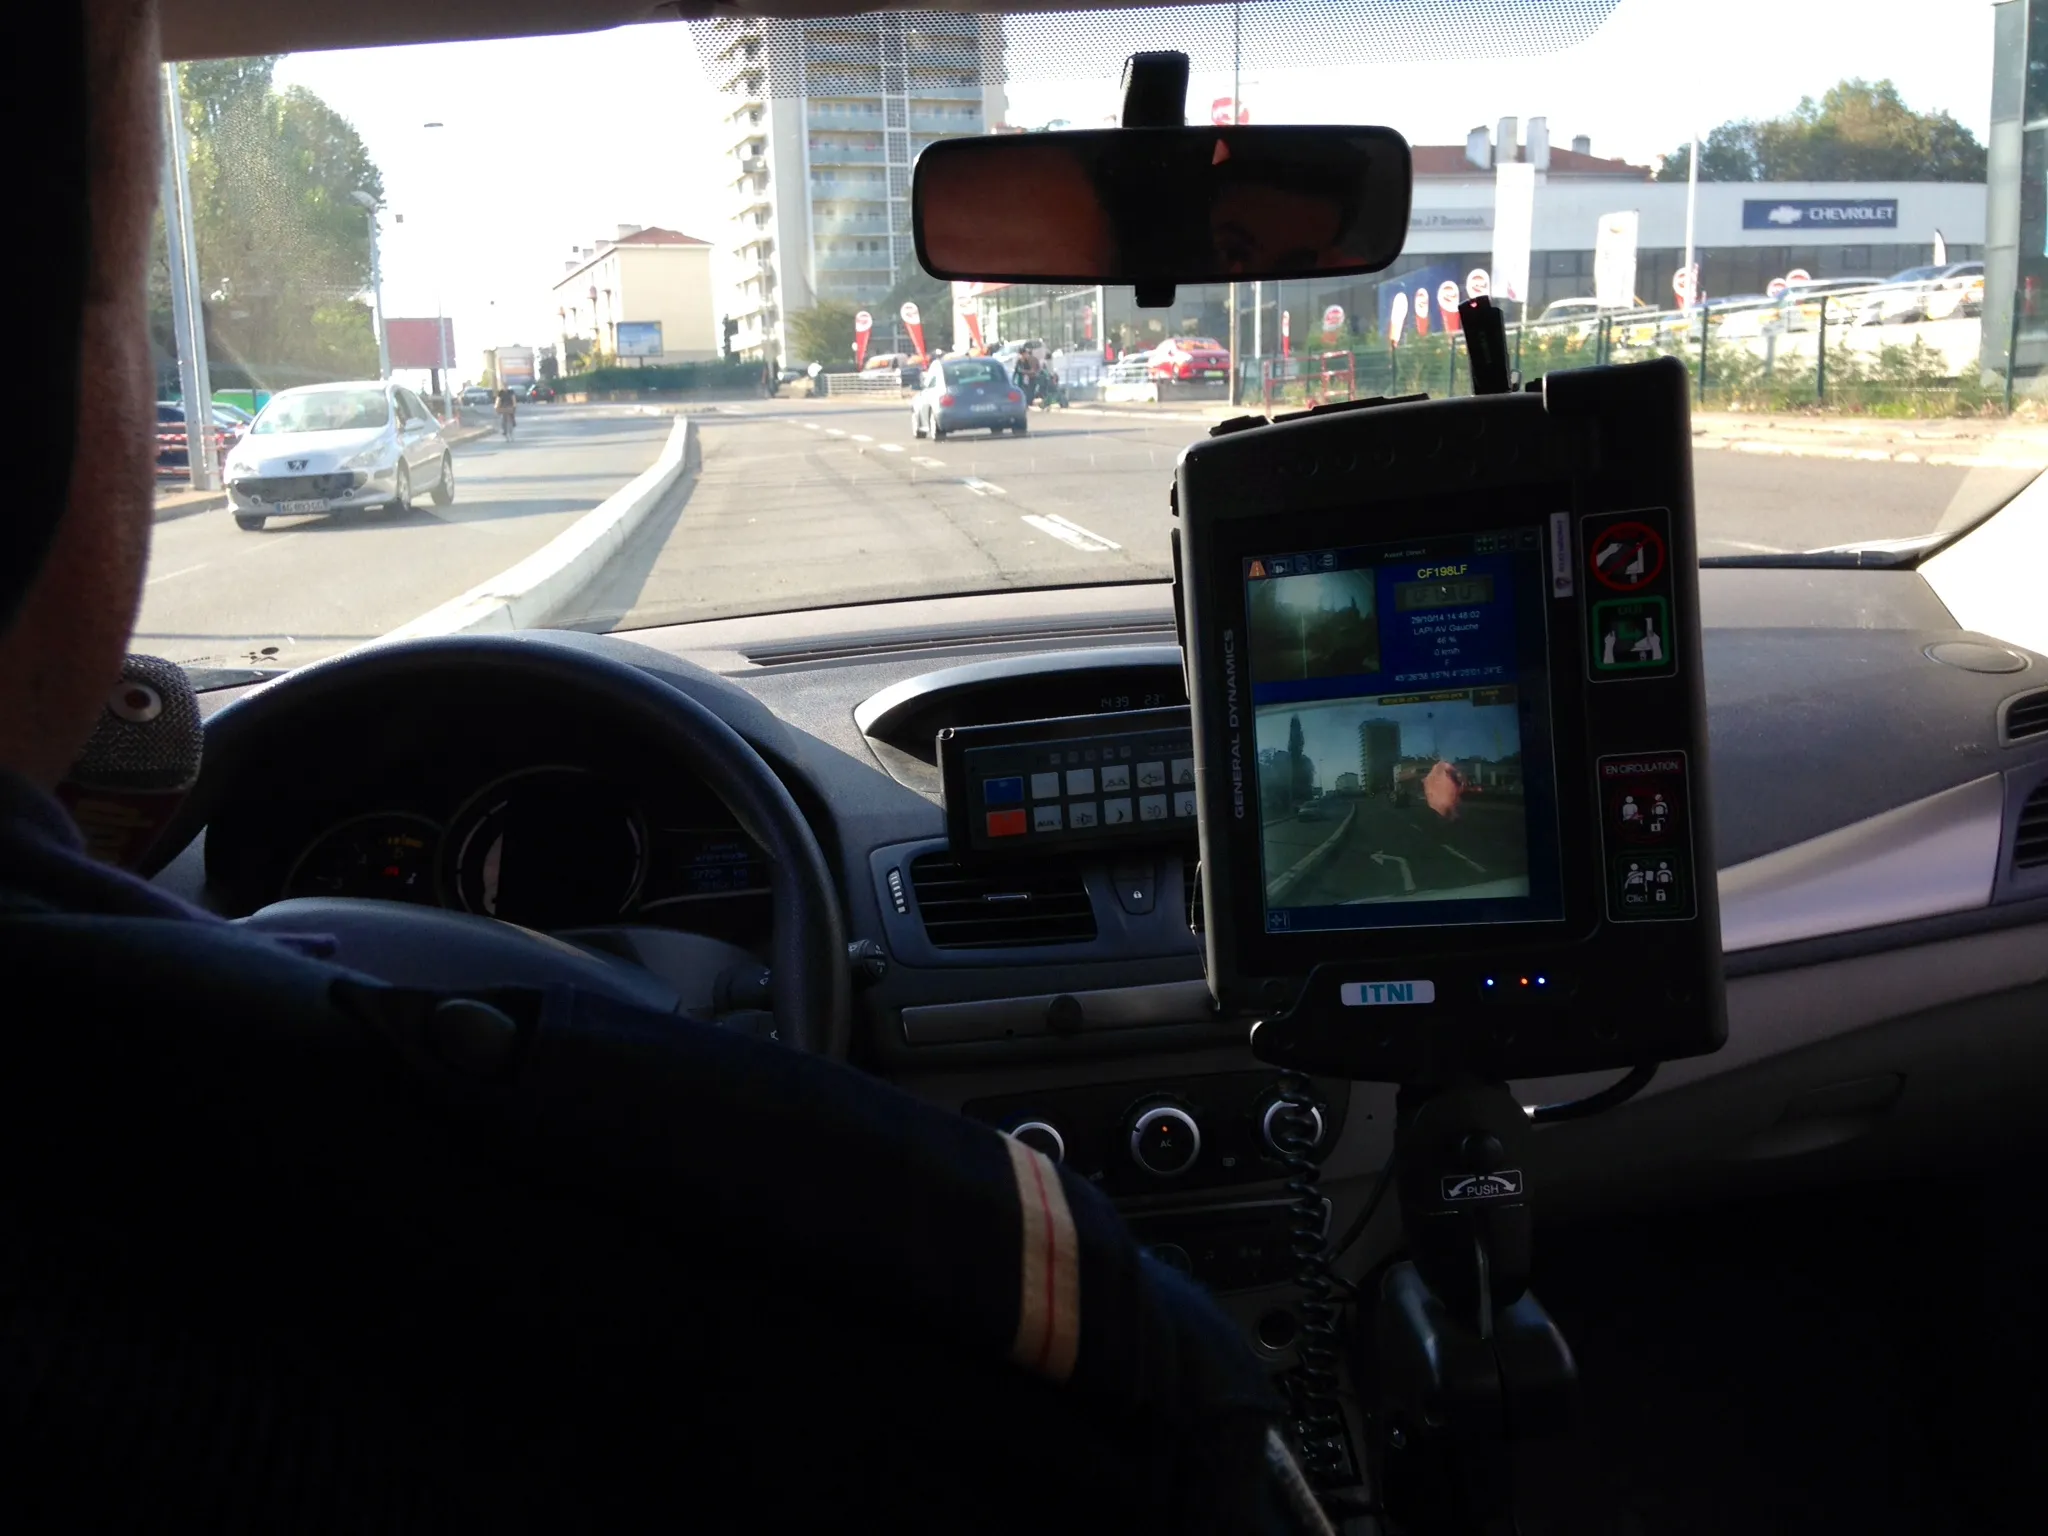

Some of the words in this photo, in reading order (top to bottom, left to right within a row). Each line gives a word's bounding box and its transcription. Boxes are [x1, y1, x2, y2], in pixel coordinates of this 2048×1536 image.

[1809, 206, 1894, 220] CHEVROLET
[1416, 564, 1469, 579] CF198LF
[1434, 625, 1447, 634] AV
[1448, 623, 1480, 632] Gauche
[1223, 628, 1239, 728] DYNAMICS
[1605, 765, 1619, 775] EN
[1620, 760, 1679, 774] CIRCULATION
[1231, 733, 1245, 820] GENERAL
[1360, 983, 1414, 1003] ITNI
[1159, 1138, 1173, 1149] AC
[1466, 1184, 1500, 1197] PUSH
